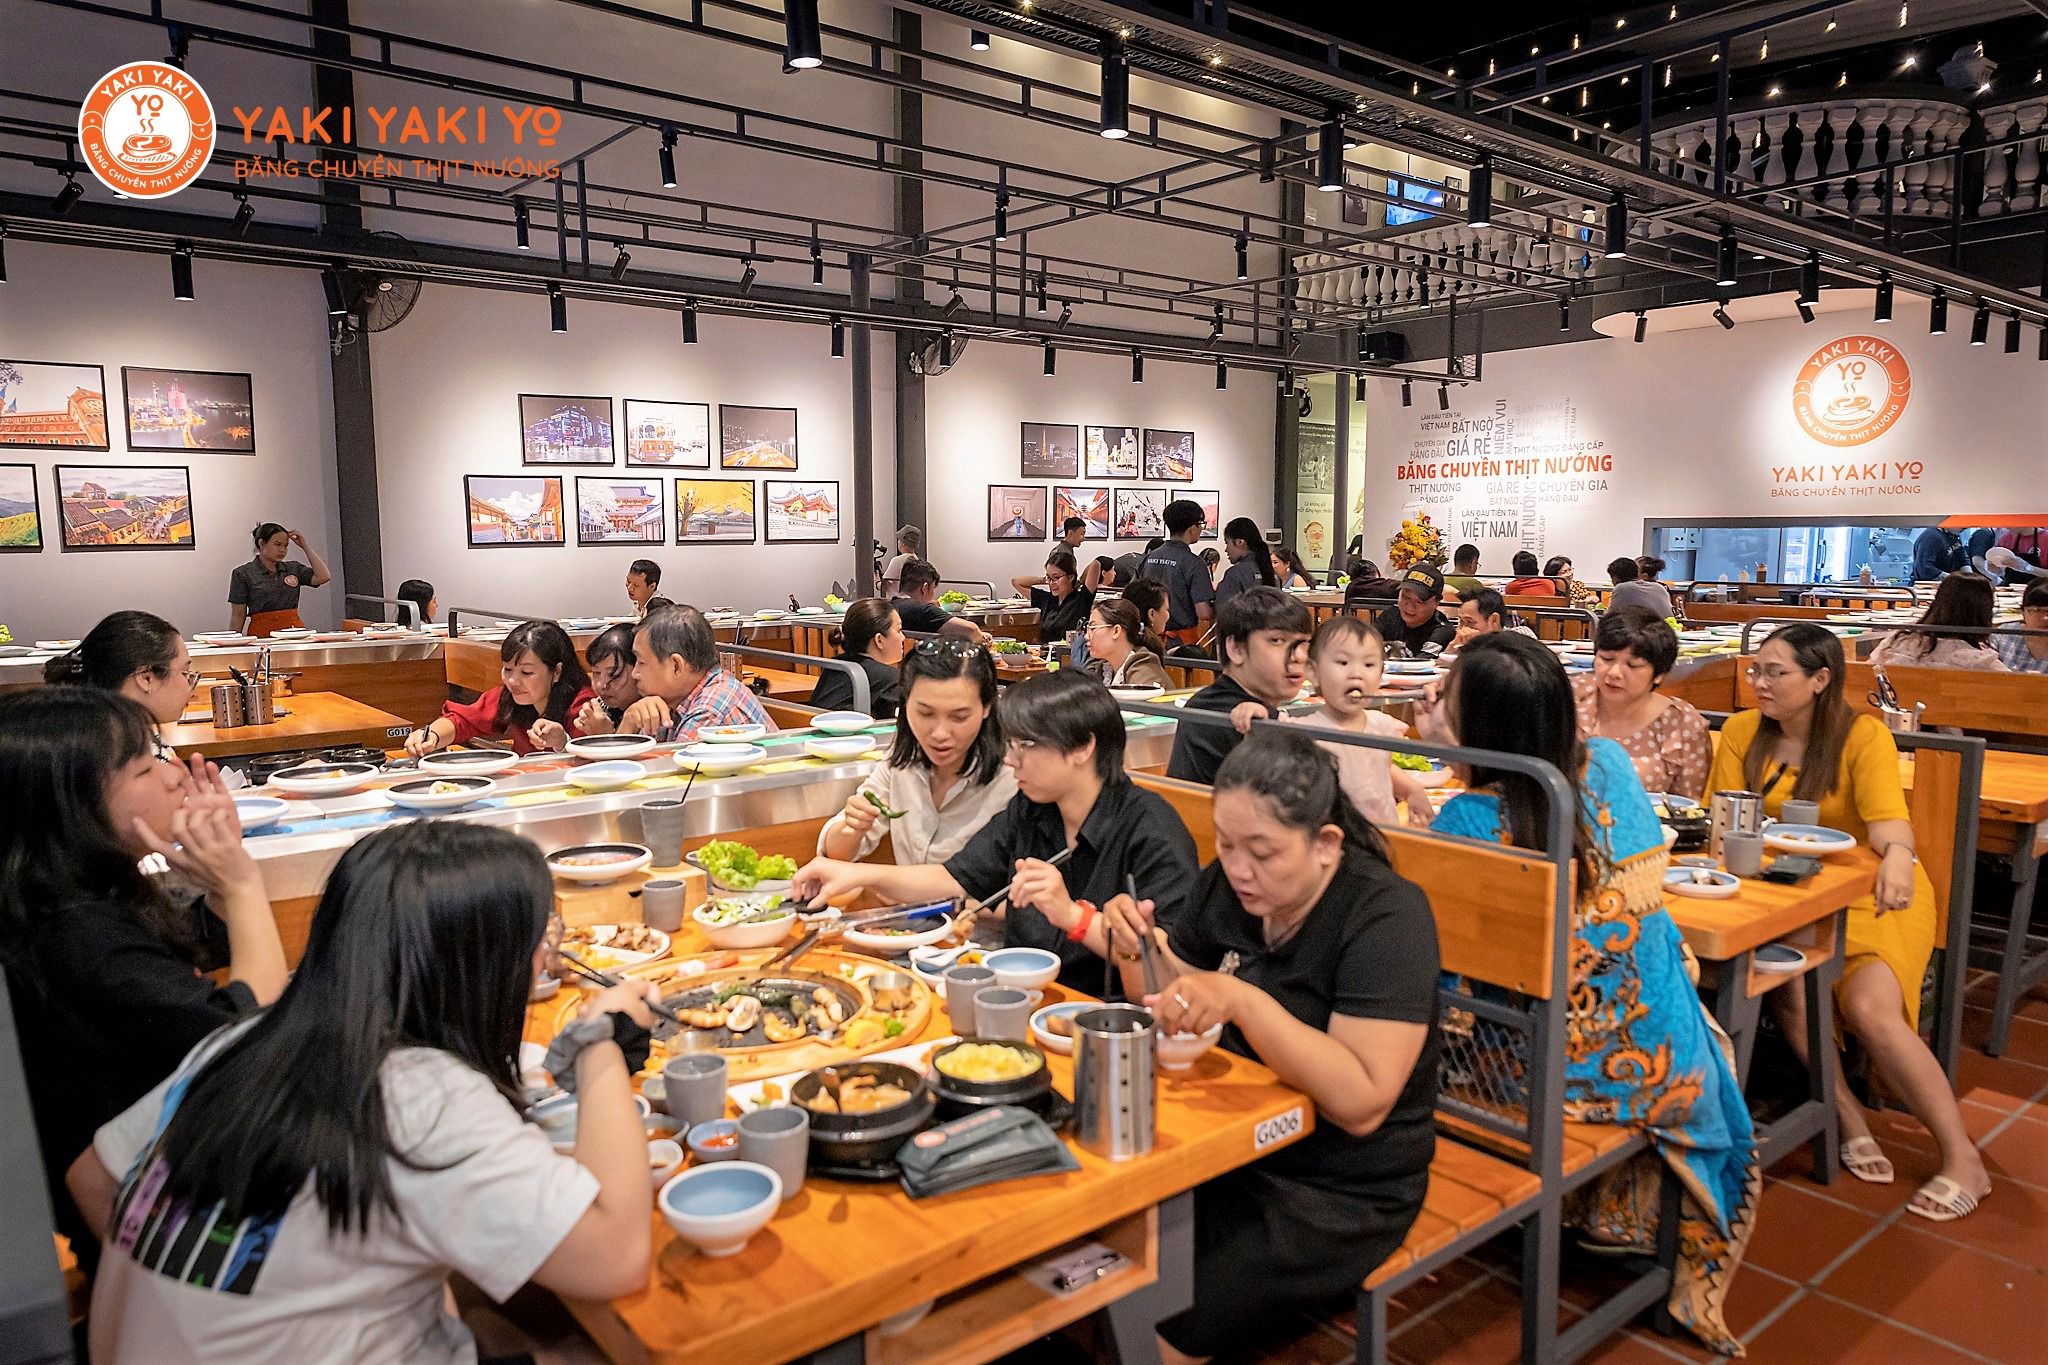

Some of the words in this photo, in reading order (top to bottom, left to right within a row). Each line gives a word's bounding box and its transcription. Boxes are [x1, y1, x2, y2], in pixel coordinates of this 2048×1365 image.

[1810, 341, 1849, 369] YAKI
[1857, 340, 1895, 364] YAKI
[1836, 361, 1866, 381] YO
[1495, 399, 1507, 421] VUI
[1452, 417, 1471, 434] BẤT
[1472, 416, 1494, 432] NGỜ
[1446, 434, 1470, 457] GIÁ
[1473, 432, 1492, 455] RẺ
[1397, 460, 1437, 480] BĂNG
[1441, 455, 1500, 478] CHUYỀN
[1505, 458, 1540, 480] THỊT
[1545, 452, 1613, 474] NƯỚNG
[1772, 465, 1824, 483] YAKI
[1831, 462, 1887, 481] YAKI
[1894, 461, 1924, 480] YO
[1409, 483, 1429, 496] THỊT
[1588, 479, 1609, 491] GIA
[1771, 487, 1800, 498] BĂNG
[1850, 486, 1875, 497] THỊT
[1461, 517, 1487, 542] VIỆT
[1489, 520, 1518, 538] NAM
[1521, 529, 1538, 550] HỊT
[388, 727, 411, 737] G019
[1256, 1111, 1298, 1145] G006
